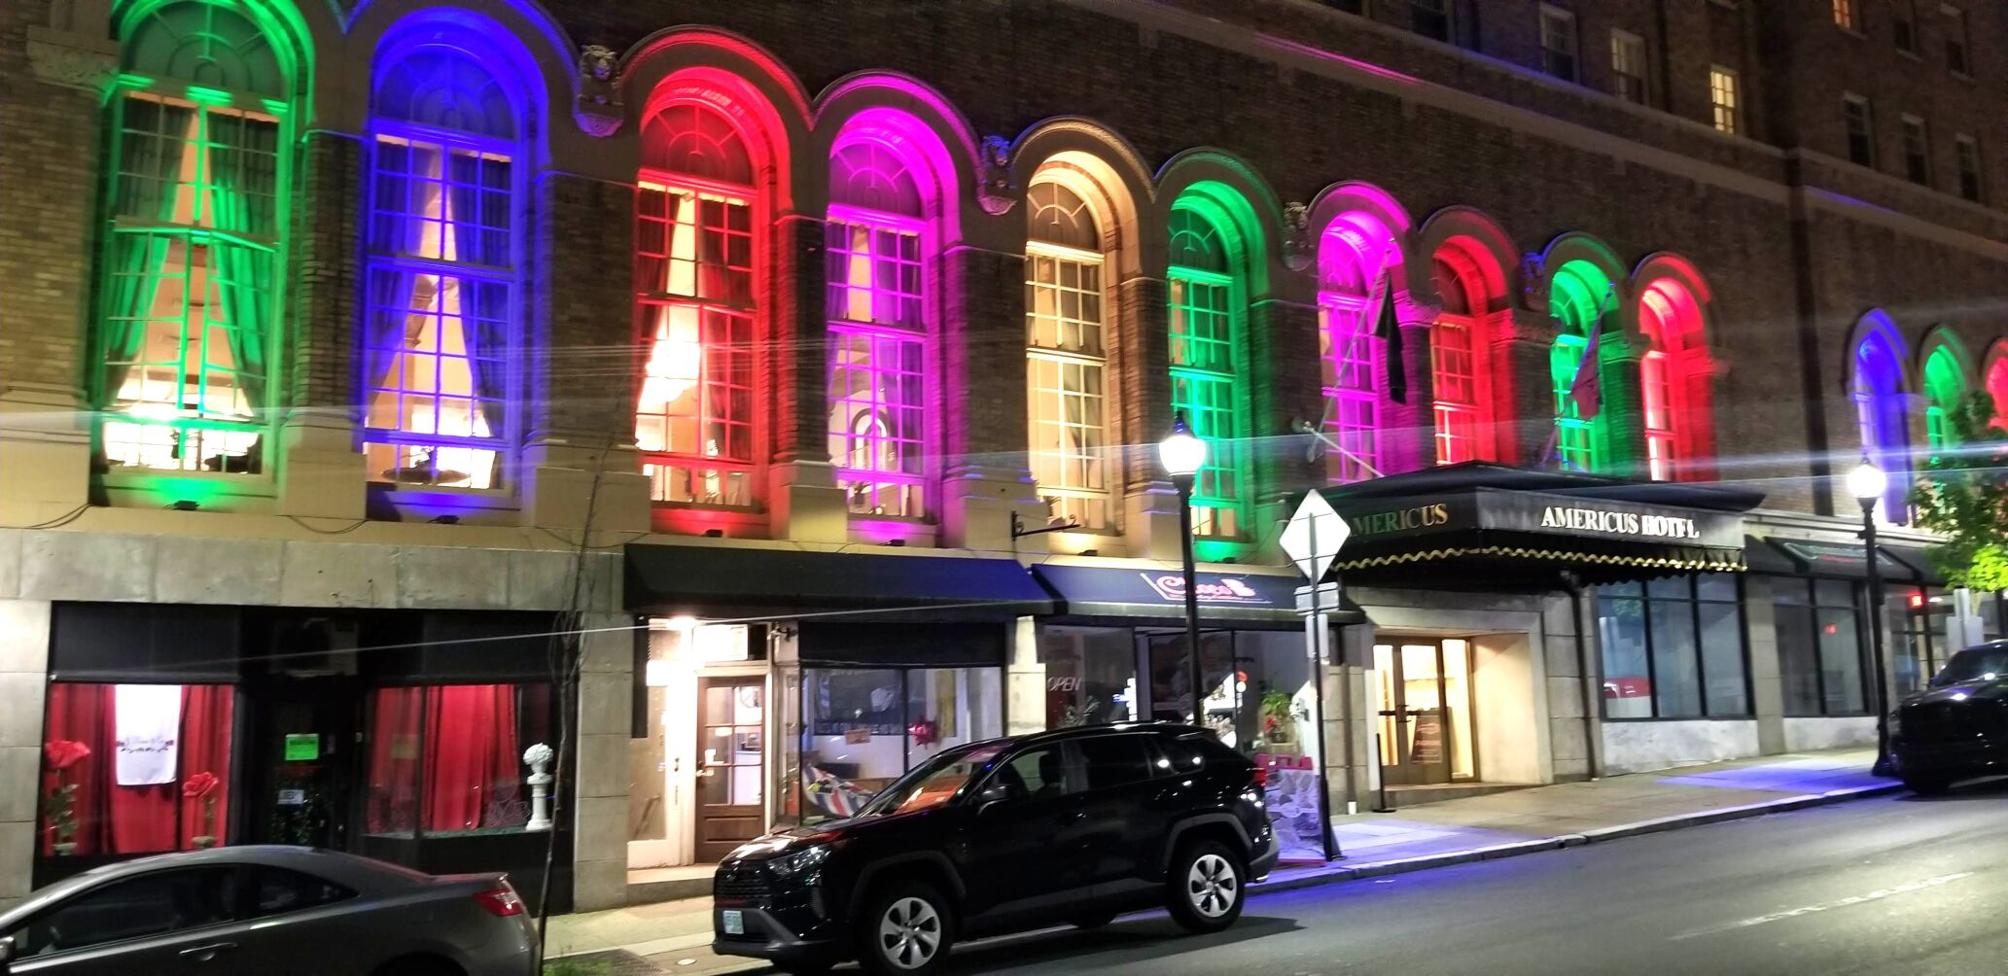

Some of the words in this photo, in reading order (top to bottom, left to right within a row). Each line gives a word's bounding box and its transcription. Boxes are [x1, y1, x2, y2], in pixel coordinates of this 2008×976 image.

[1349, 503, 1449, 537] MERICUS
[1541, 506, 1639, 534] AMERICUS
[1641, 515, 1700, 539] HOTEL
[1047, 676, 1082, 692] OPEN
